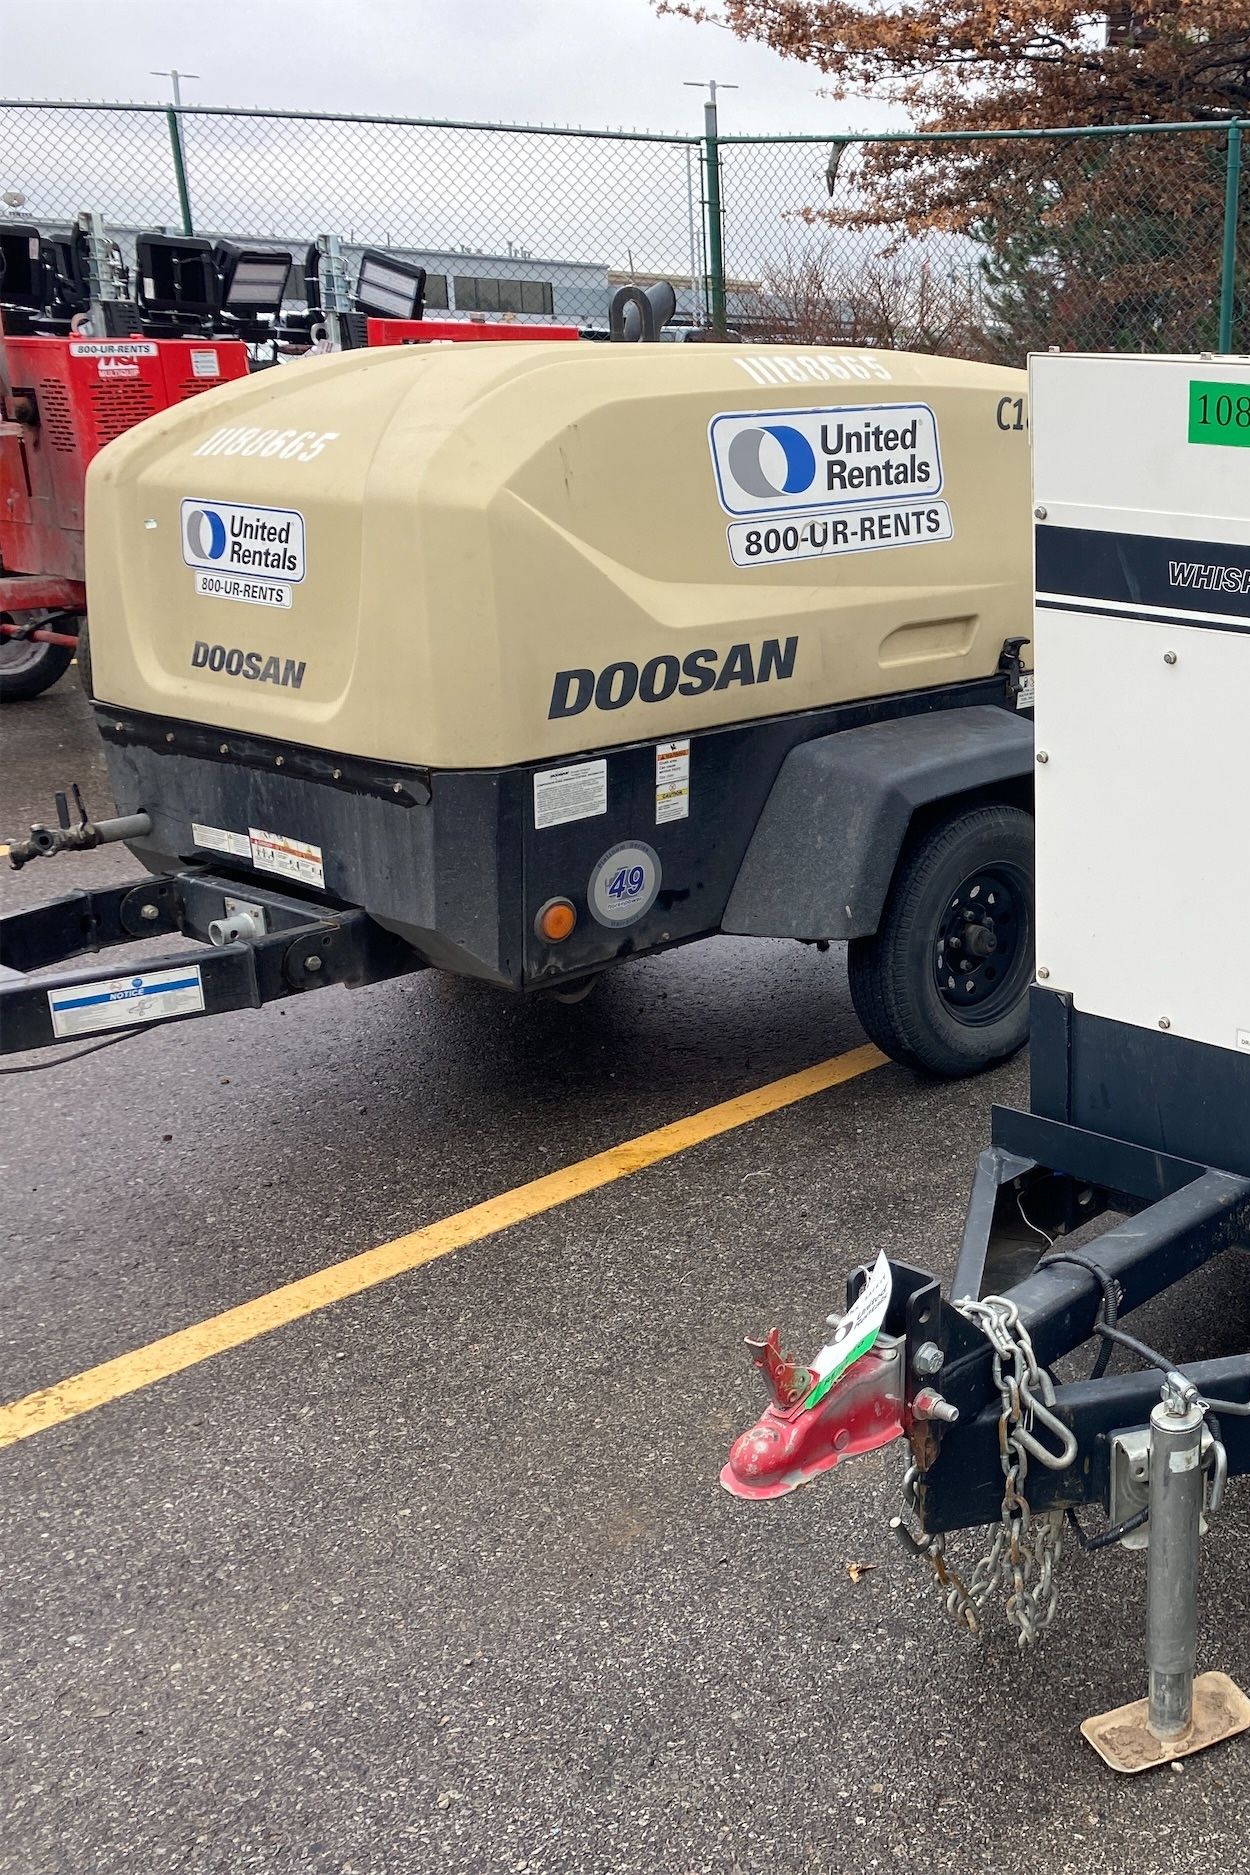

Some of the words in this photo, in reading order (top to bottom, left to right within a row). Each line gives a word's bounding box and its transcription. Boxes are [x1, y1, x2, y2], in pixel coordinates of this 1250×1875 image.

[78, 345, 150, 354] 800-UR-RENTS
[996, 396, 1029, 430] C1
[820, 419, 917, 455] United
[826, 454, 931, 491] Rentals
[230, 515, 290, 544] United
[745, 509, 941, 556] 800-UR-RENTS
[230, 541, 297, 572] Rentals
[202, 577, 284, 603] 800-UR-RENTS
[191, 640, 307, 689] DOOSAN
[547, 636, 799, 720] DOOSAN
[608, 865, 645, 899] 49
[109, 988, 144, 1000] NOTICE
